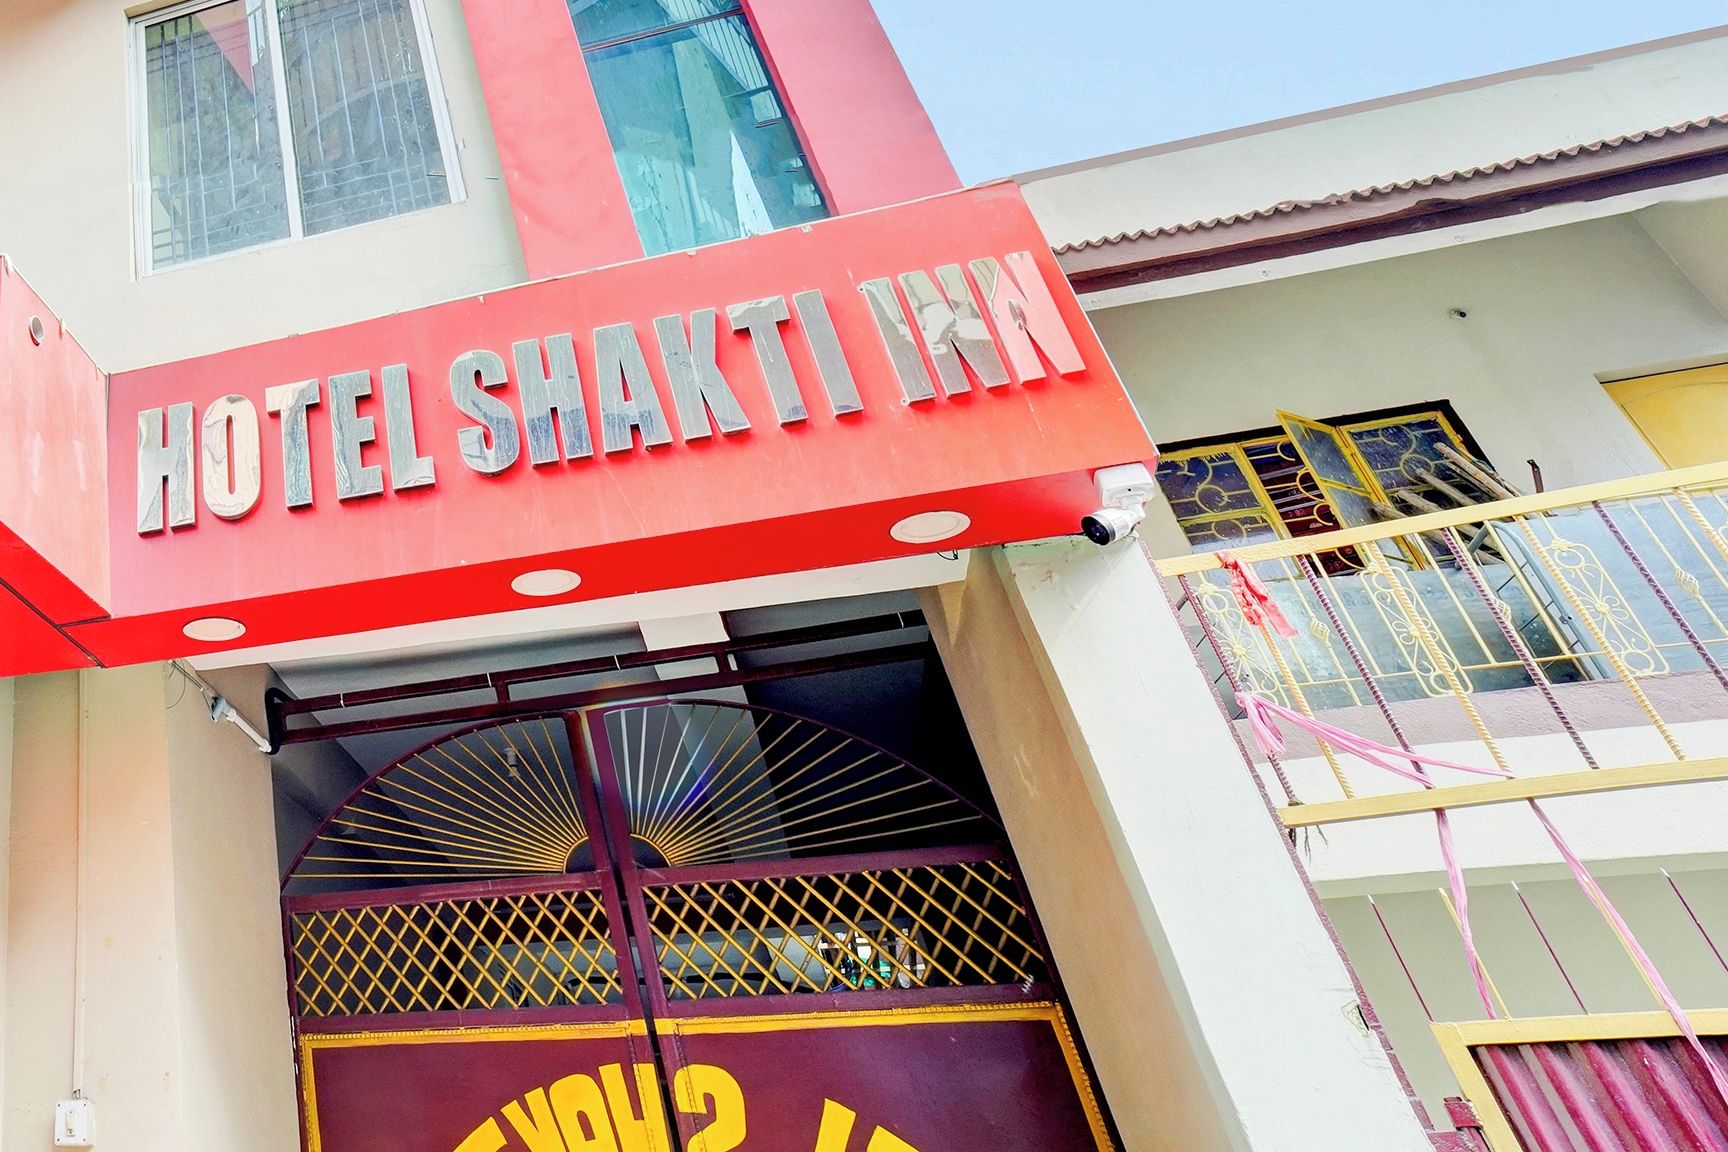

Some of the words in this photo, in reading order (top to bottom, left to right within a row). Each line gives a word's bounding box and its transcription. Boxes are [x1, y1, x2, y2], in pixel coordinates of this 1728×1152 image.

[138, 363, 437, 536] HOTEL
[449, 289, 864, 478] SHAKTI
[859, 250, 1088, 407] INN
